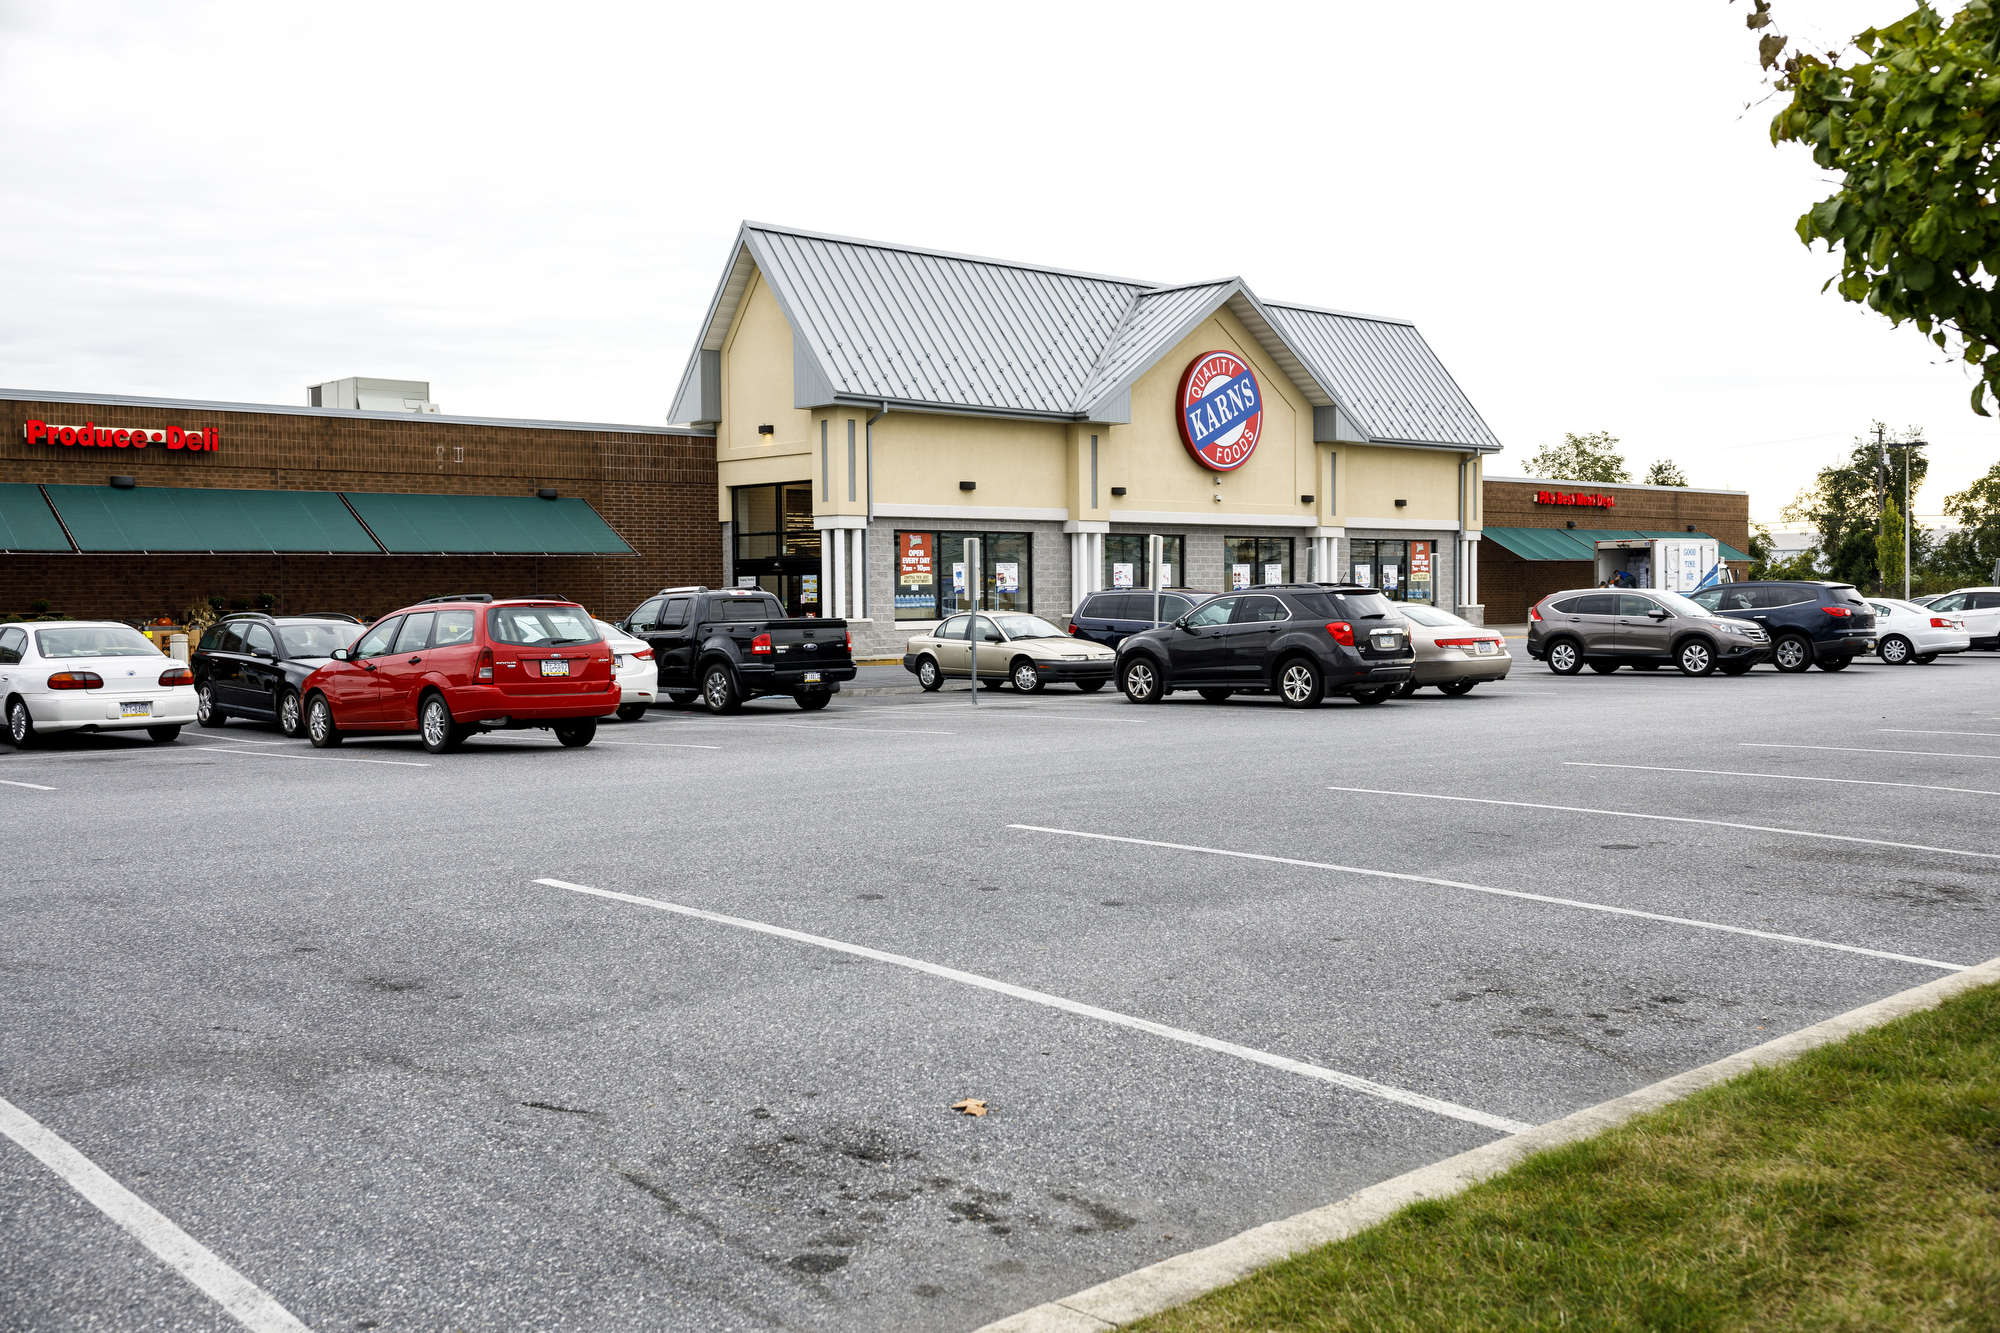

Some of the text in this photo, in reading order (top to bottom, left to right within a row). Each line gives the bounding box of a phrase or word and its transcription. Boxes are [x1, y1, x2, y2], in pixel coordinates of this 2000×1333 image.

[1191, 359, 1236, 399] QUALITY
[1189, 378, 1255, 441] KARNS
[26, 419, 219, 452] Produce Deli
[1216, 429, 1254, 463] FOODS
[1538, 491, 1555, 505] PA's
[1557, 492, 1575, 505] Best
[1576, 493, 1596, 506] Meat
[908, 549, 925, 557] OPEN
[1684, 548, 1696, 556] GOOD
[902, 564, 931, 573] 7am 10pm
[1684, 560, 1696, 568] TIME
[1686, 573, 1694, 581] ICE
